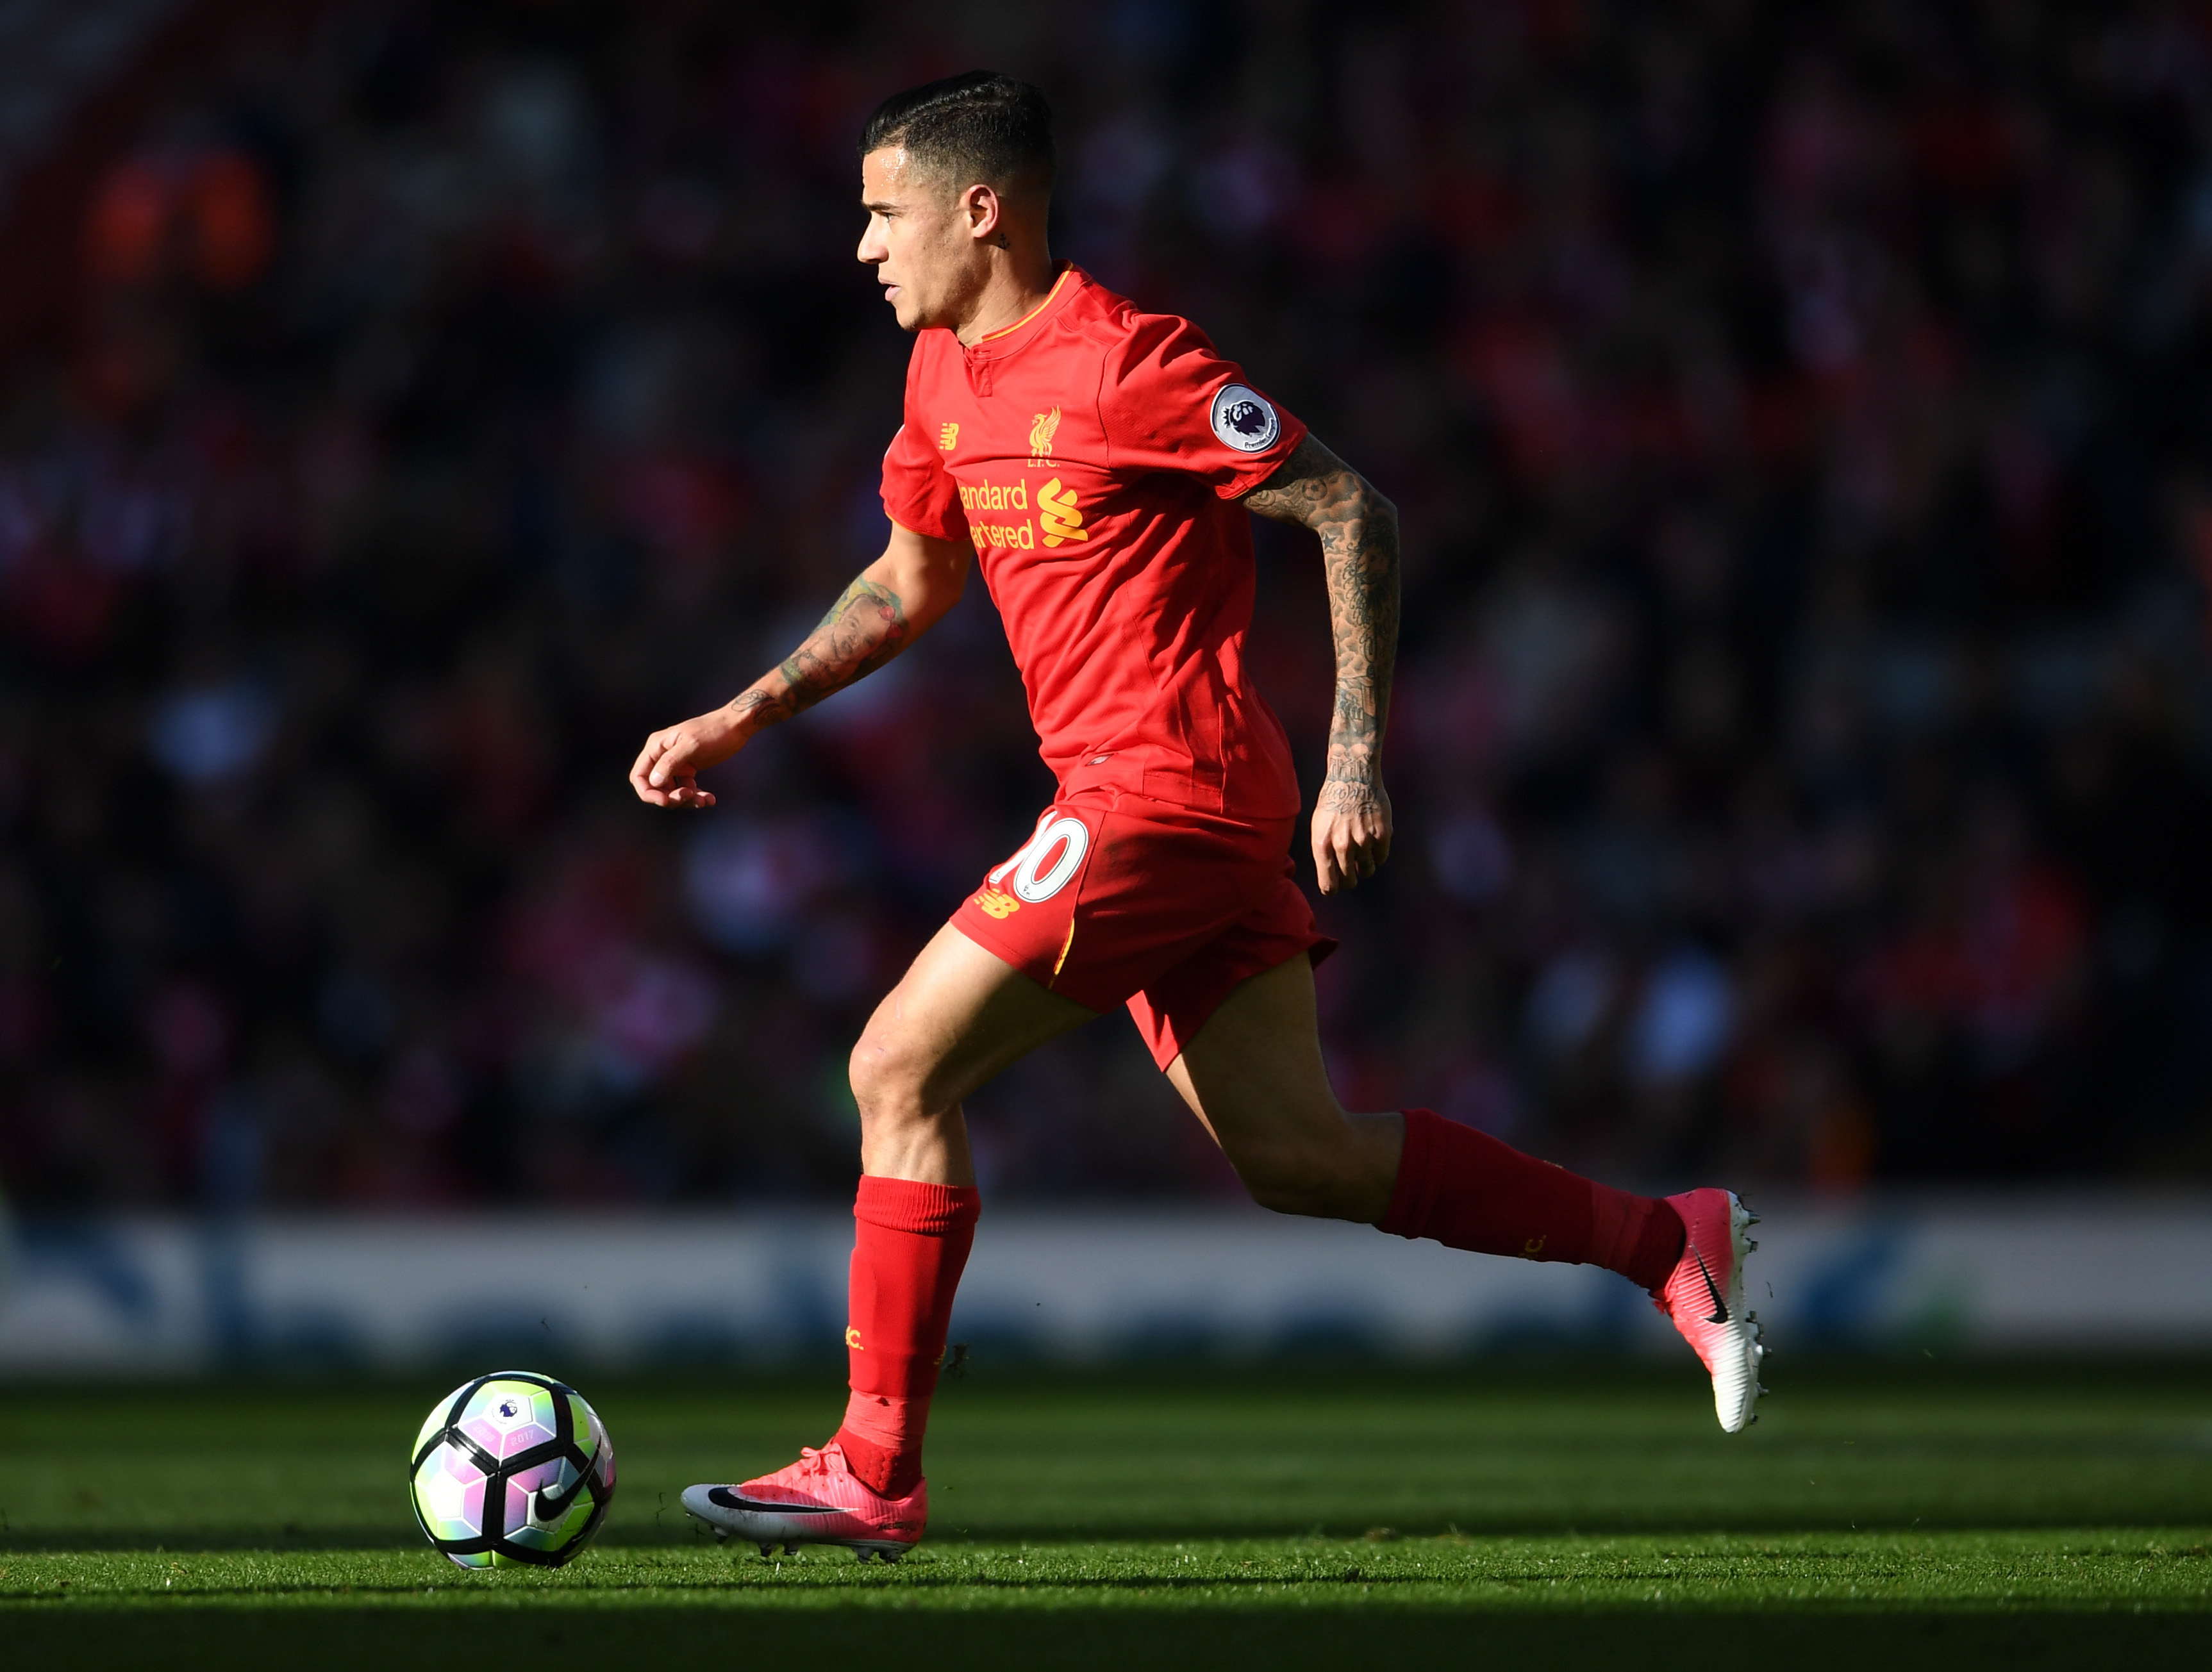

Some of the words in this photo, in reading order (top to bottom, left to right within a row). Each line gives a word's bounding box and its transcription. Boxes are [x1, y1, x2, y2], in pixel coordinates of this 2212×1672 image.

[961, 478, 1028, 510] andard
[970, 518, 1035, 550] artered
[988, 810, 1089, 903] 10
[510, 1429, 534, 1446] 2017
